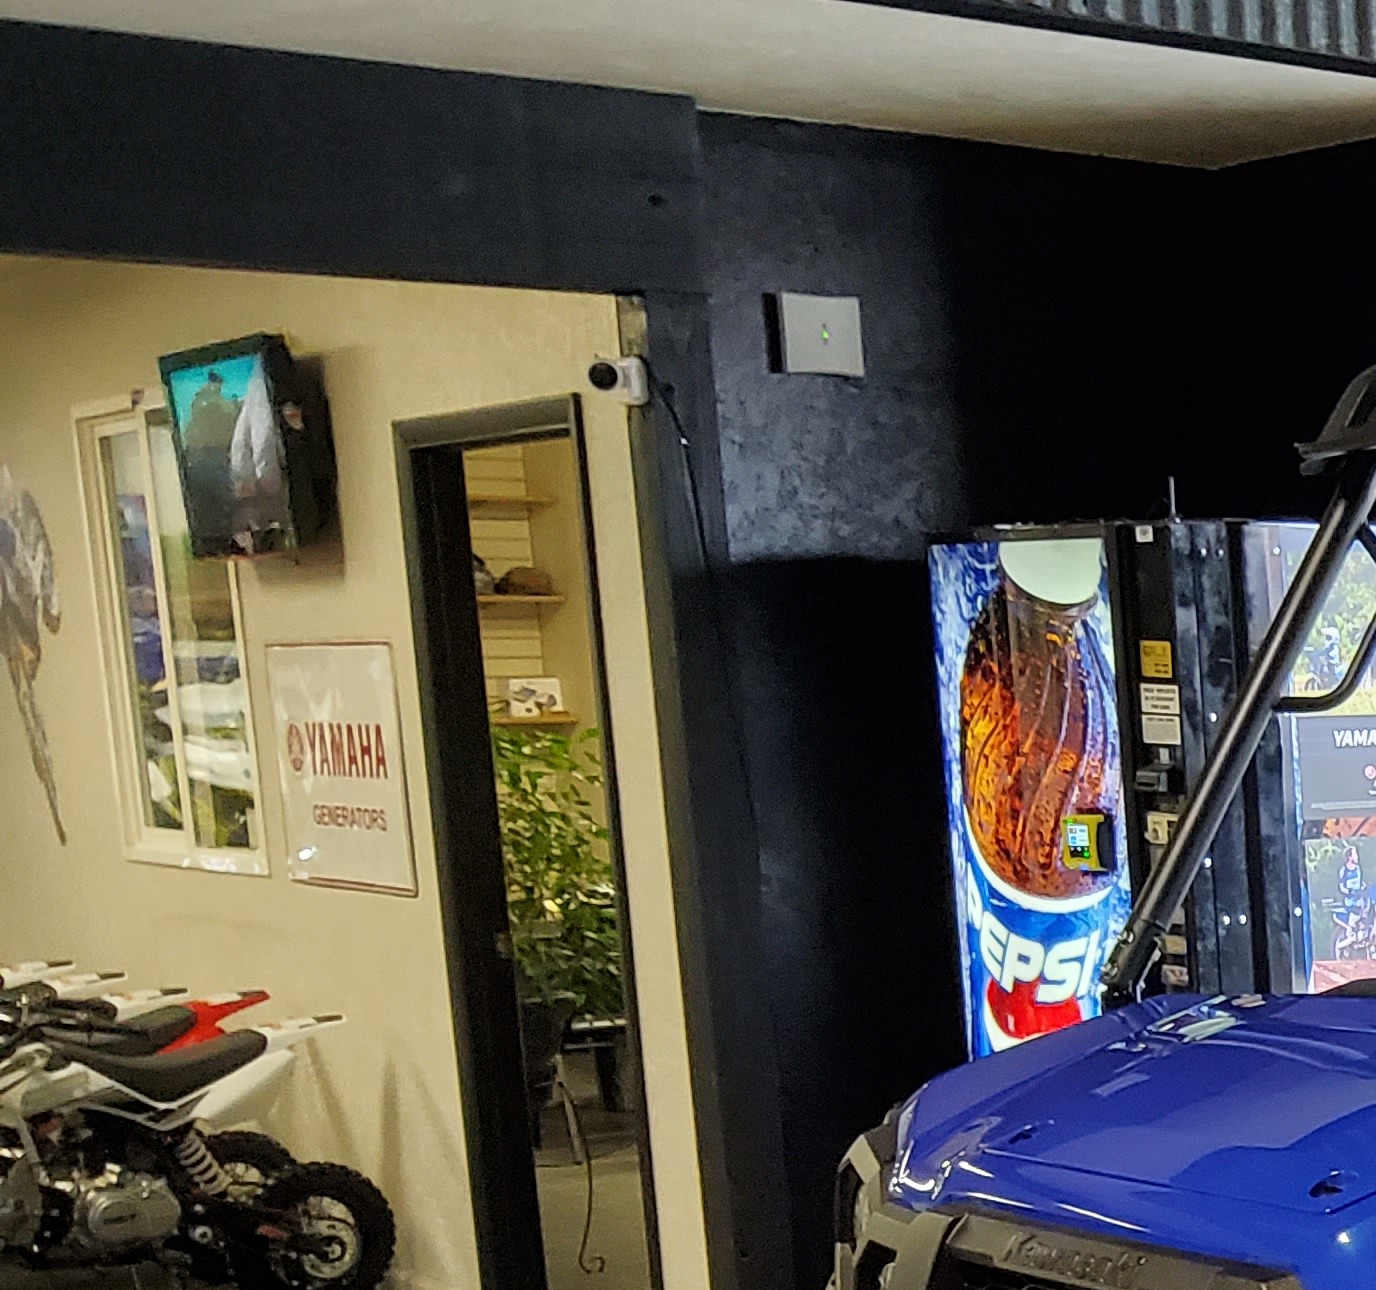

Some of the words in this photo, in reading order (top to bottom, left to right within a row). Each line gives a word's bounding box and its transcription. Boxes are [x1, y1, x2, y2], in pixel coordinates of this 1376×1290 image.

[304, 721, 388, 779] YAMAHA
[313, 804, 388, 832] GENERATORS
[966, 861, 1101, 1004] PEPSI
